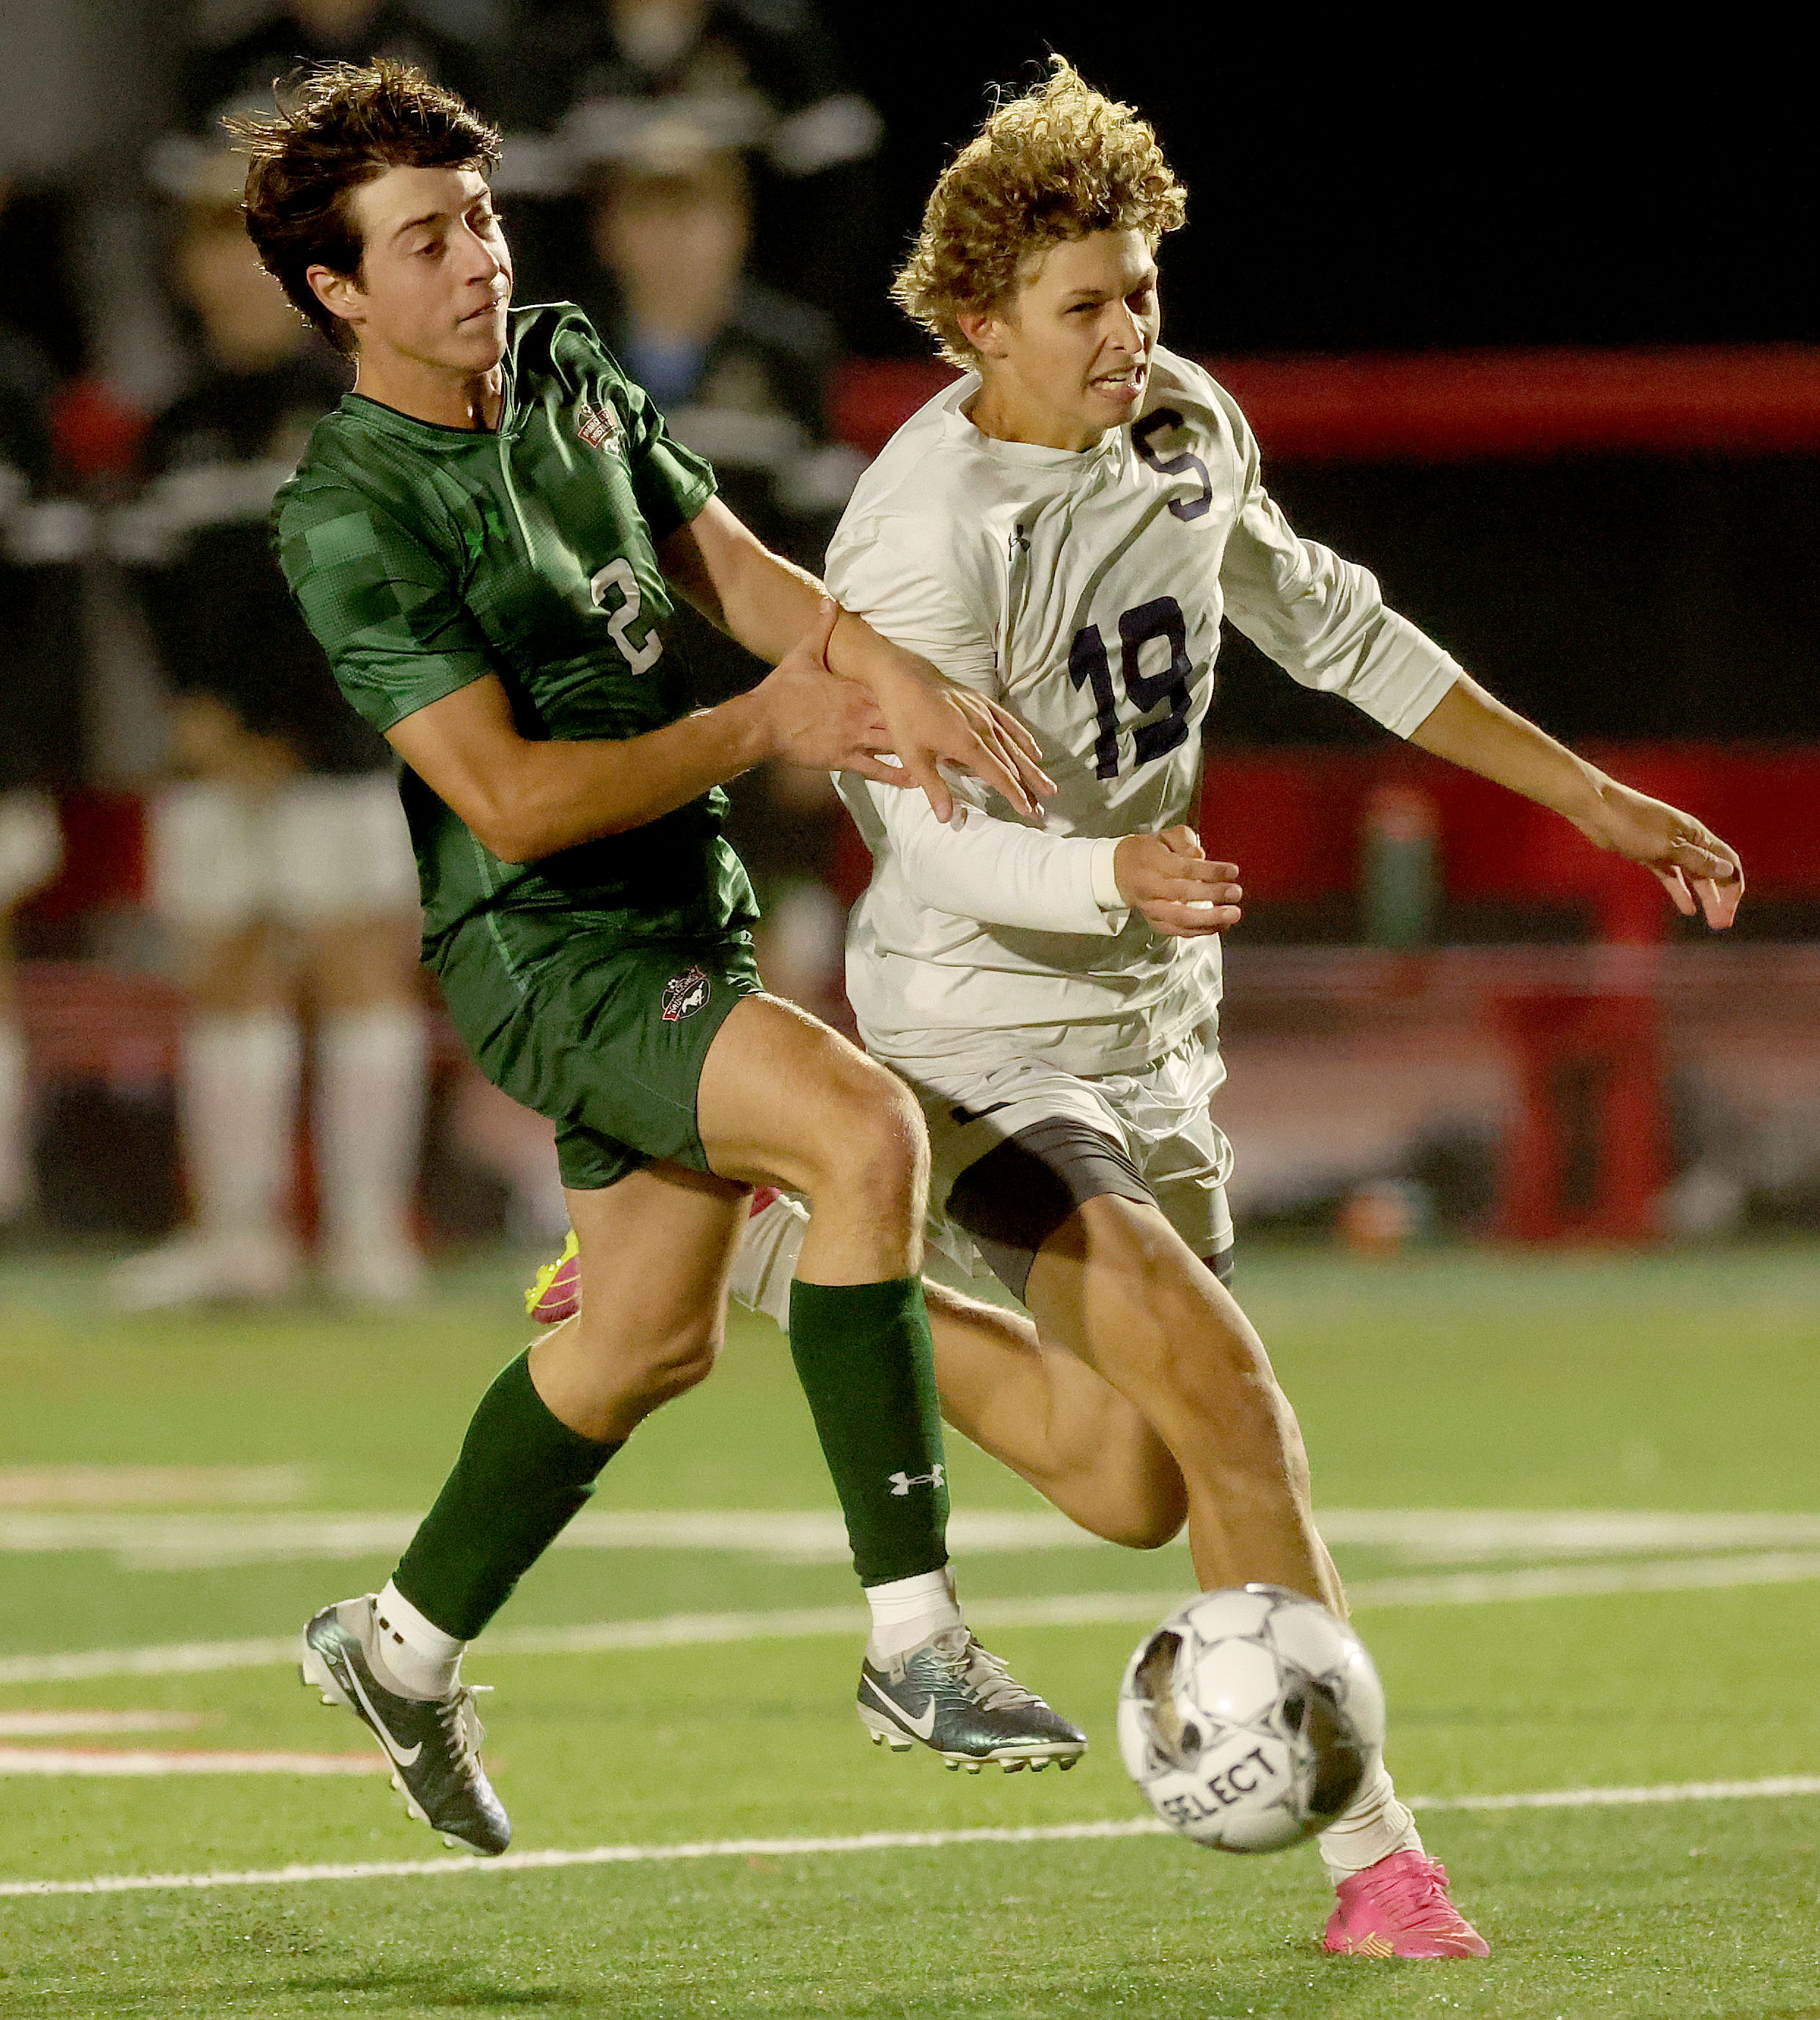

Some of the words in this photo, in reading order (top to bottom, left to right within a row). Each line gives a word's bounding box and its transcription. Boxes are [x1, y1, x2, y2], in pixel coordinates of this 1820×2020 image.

[1131, 406, 1213, 522] S
[591, 557, 663, 676] 2
[1068, 596, 1193, 780] 19
[1163, 1746, 1276, 1826] SELECT
